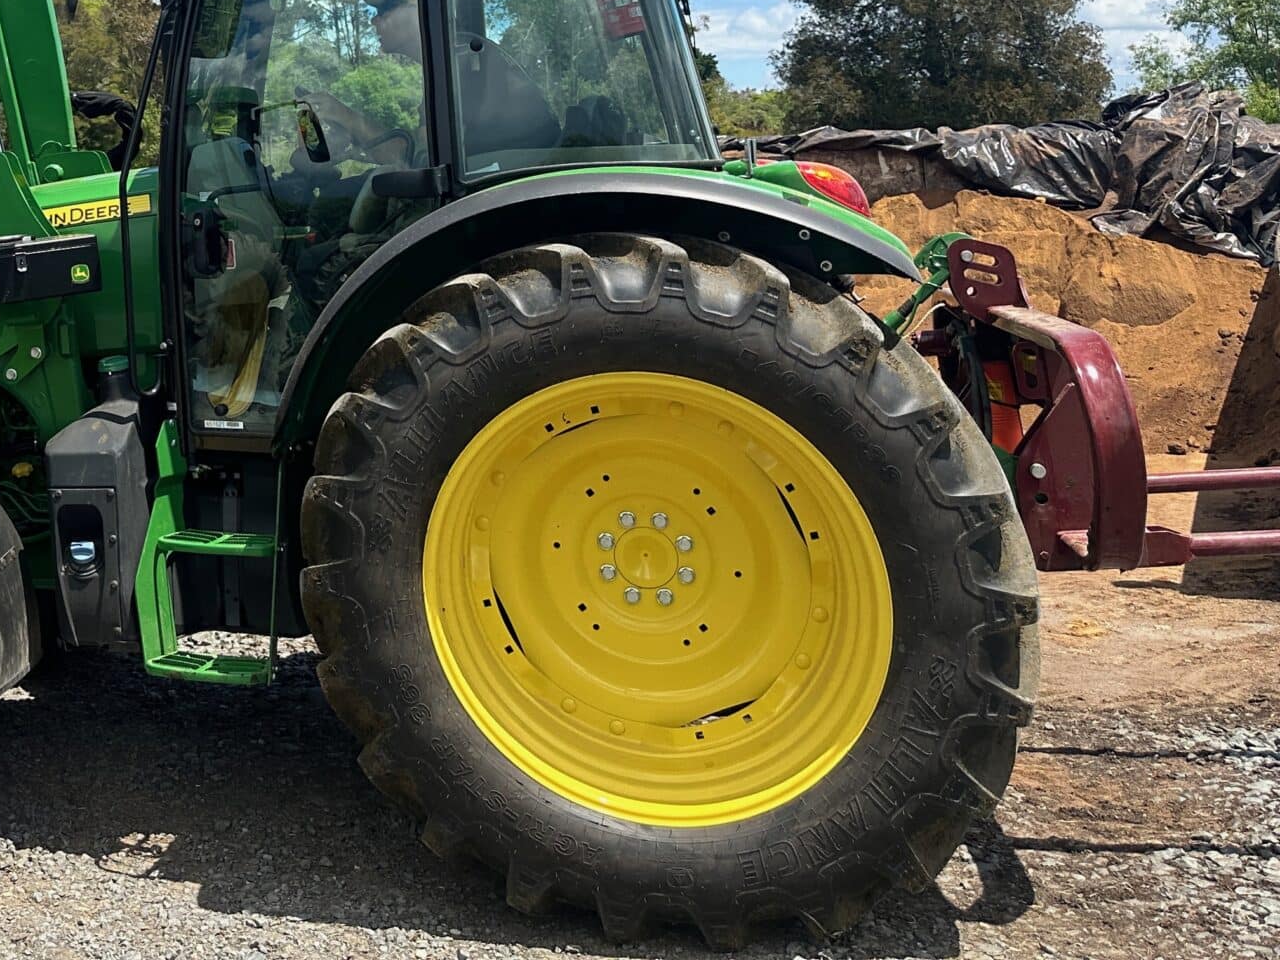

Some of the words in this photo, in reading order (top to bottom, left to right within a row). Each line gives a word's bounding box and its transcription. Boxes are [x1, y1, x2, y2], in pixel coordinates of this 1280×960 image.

[375, 326, 561, 522] ALLIANCE
[430, 734, 605, 866] AGRI-STAR
[736, 687, 948, 888] ALLIANCE
